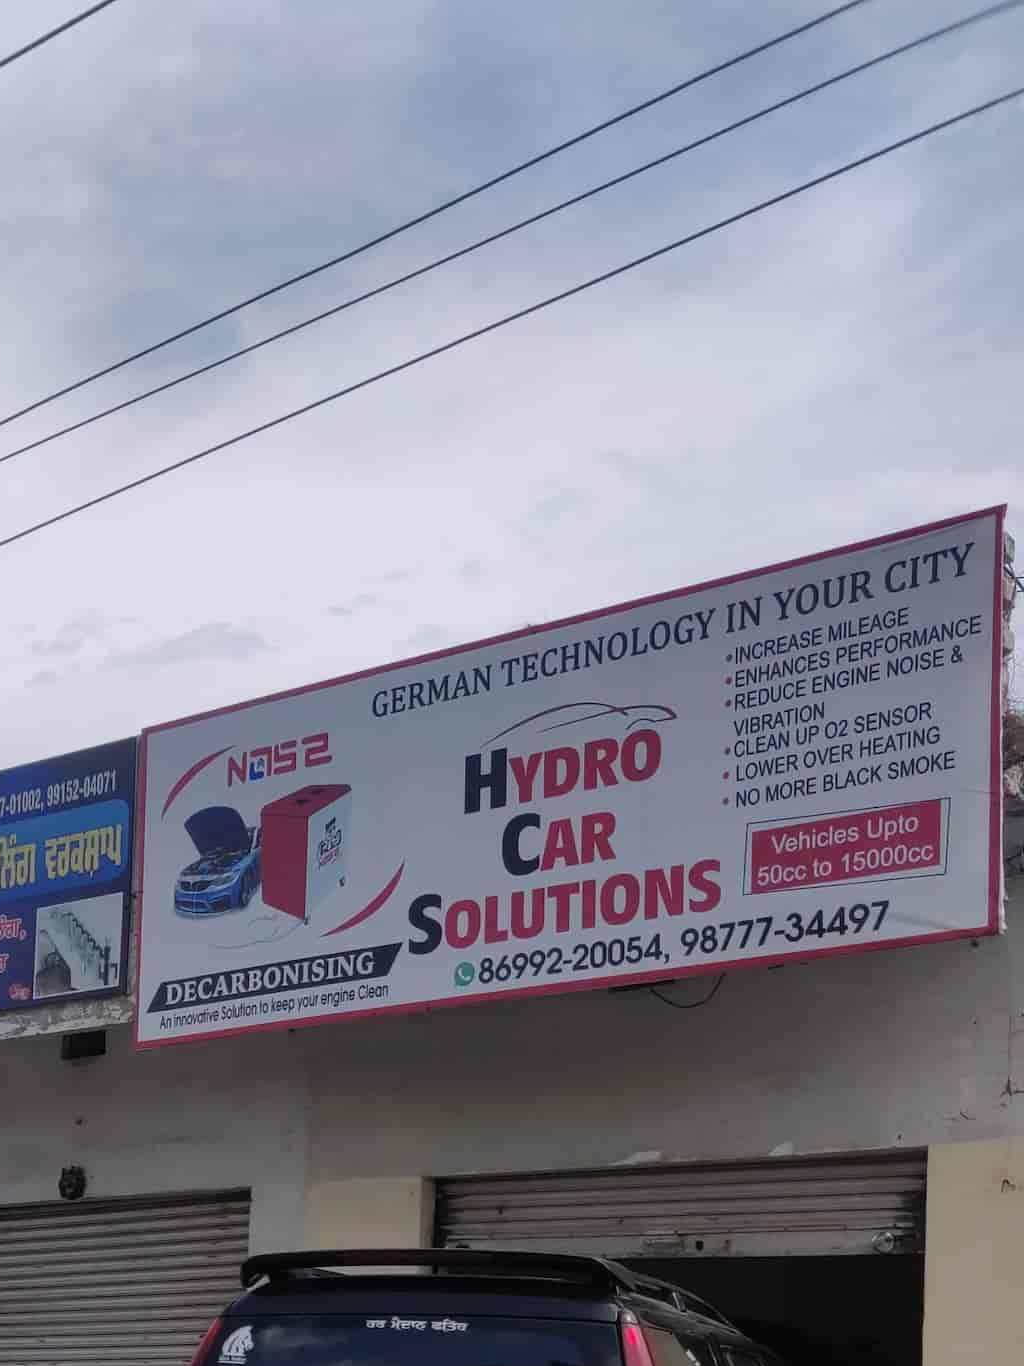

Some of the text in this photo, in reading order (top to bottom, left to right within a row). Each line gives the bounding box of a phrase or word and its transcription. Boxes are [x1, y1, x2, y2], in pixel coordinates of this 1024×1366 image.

[371, 541, 976, 720] GERMAN TECHNOLOGY IN YOUR CITY
[734, 606, 910, 666] INCREASE MILEAGE
[734, 614, 983, 689] ENHANCES PERFORMANCE
[733, 644, 964, 712] REDUCE ENGINE NOISE &
[733, 702, 825, 737] VIBRATION
[733, 728, 792, 759] CLEAN
[795, 723, 820, 746] UP
[853, 701, 932, 734] SENSOR
[464, 728, 661, 813] HYDRO
[735, 725, 941, 782] LOWER OVER HEATING
[735, 750, 957, 809] NO MORE BLACK SMOKE
[47, 769, 117, 807] 99152-04071
[502, 811, 616, 876] CAR
[770, 814, 920, 856] Vehicles Upto
[757, 844, 935, 886] 50cc to 15000cc
[407, 858, 722, 955] SOLUTIONS
[479, 901, 890, 985] 86992-20054, 98777-34497
[160, 1015, 172, 1030] An
[221, 1001, 257, 1020] Solution
[259, 1001, 269, 1014] to
[270, 996, 295, 1016] keep
[297, 994, 319, 1012] your
[320, 989, 355, 1008] engine
[357, 983, 389, 999] Clean
[166, 951, 375, 1005] DECARBONISING
